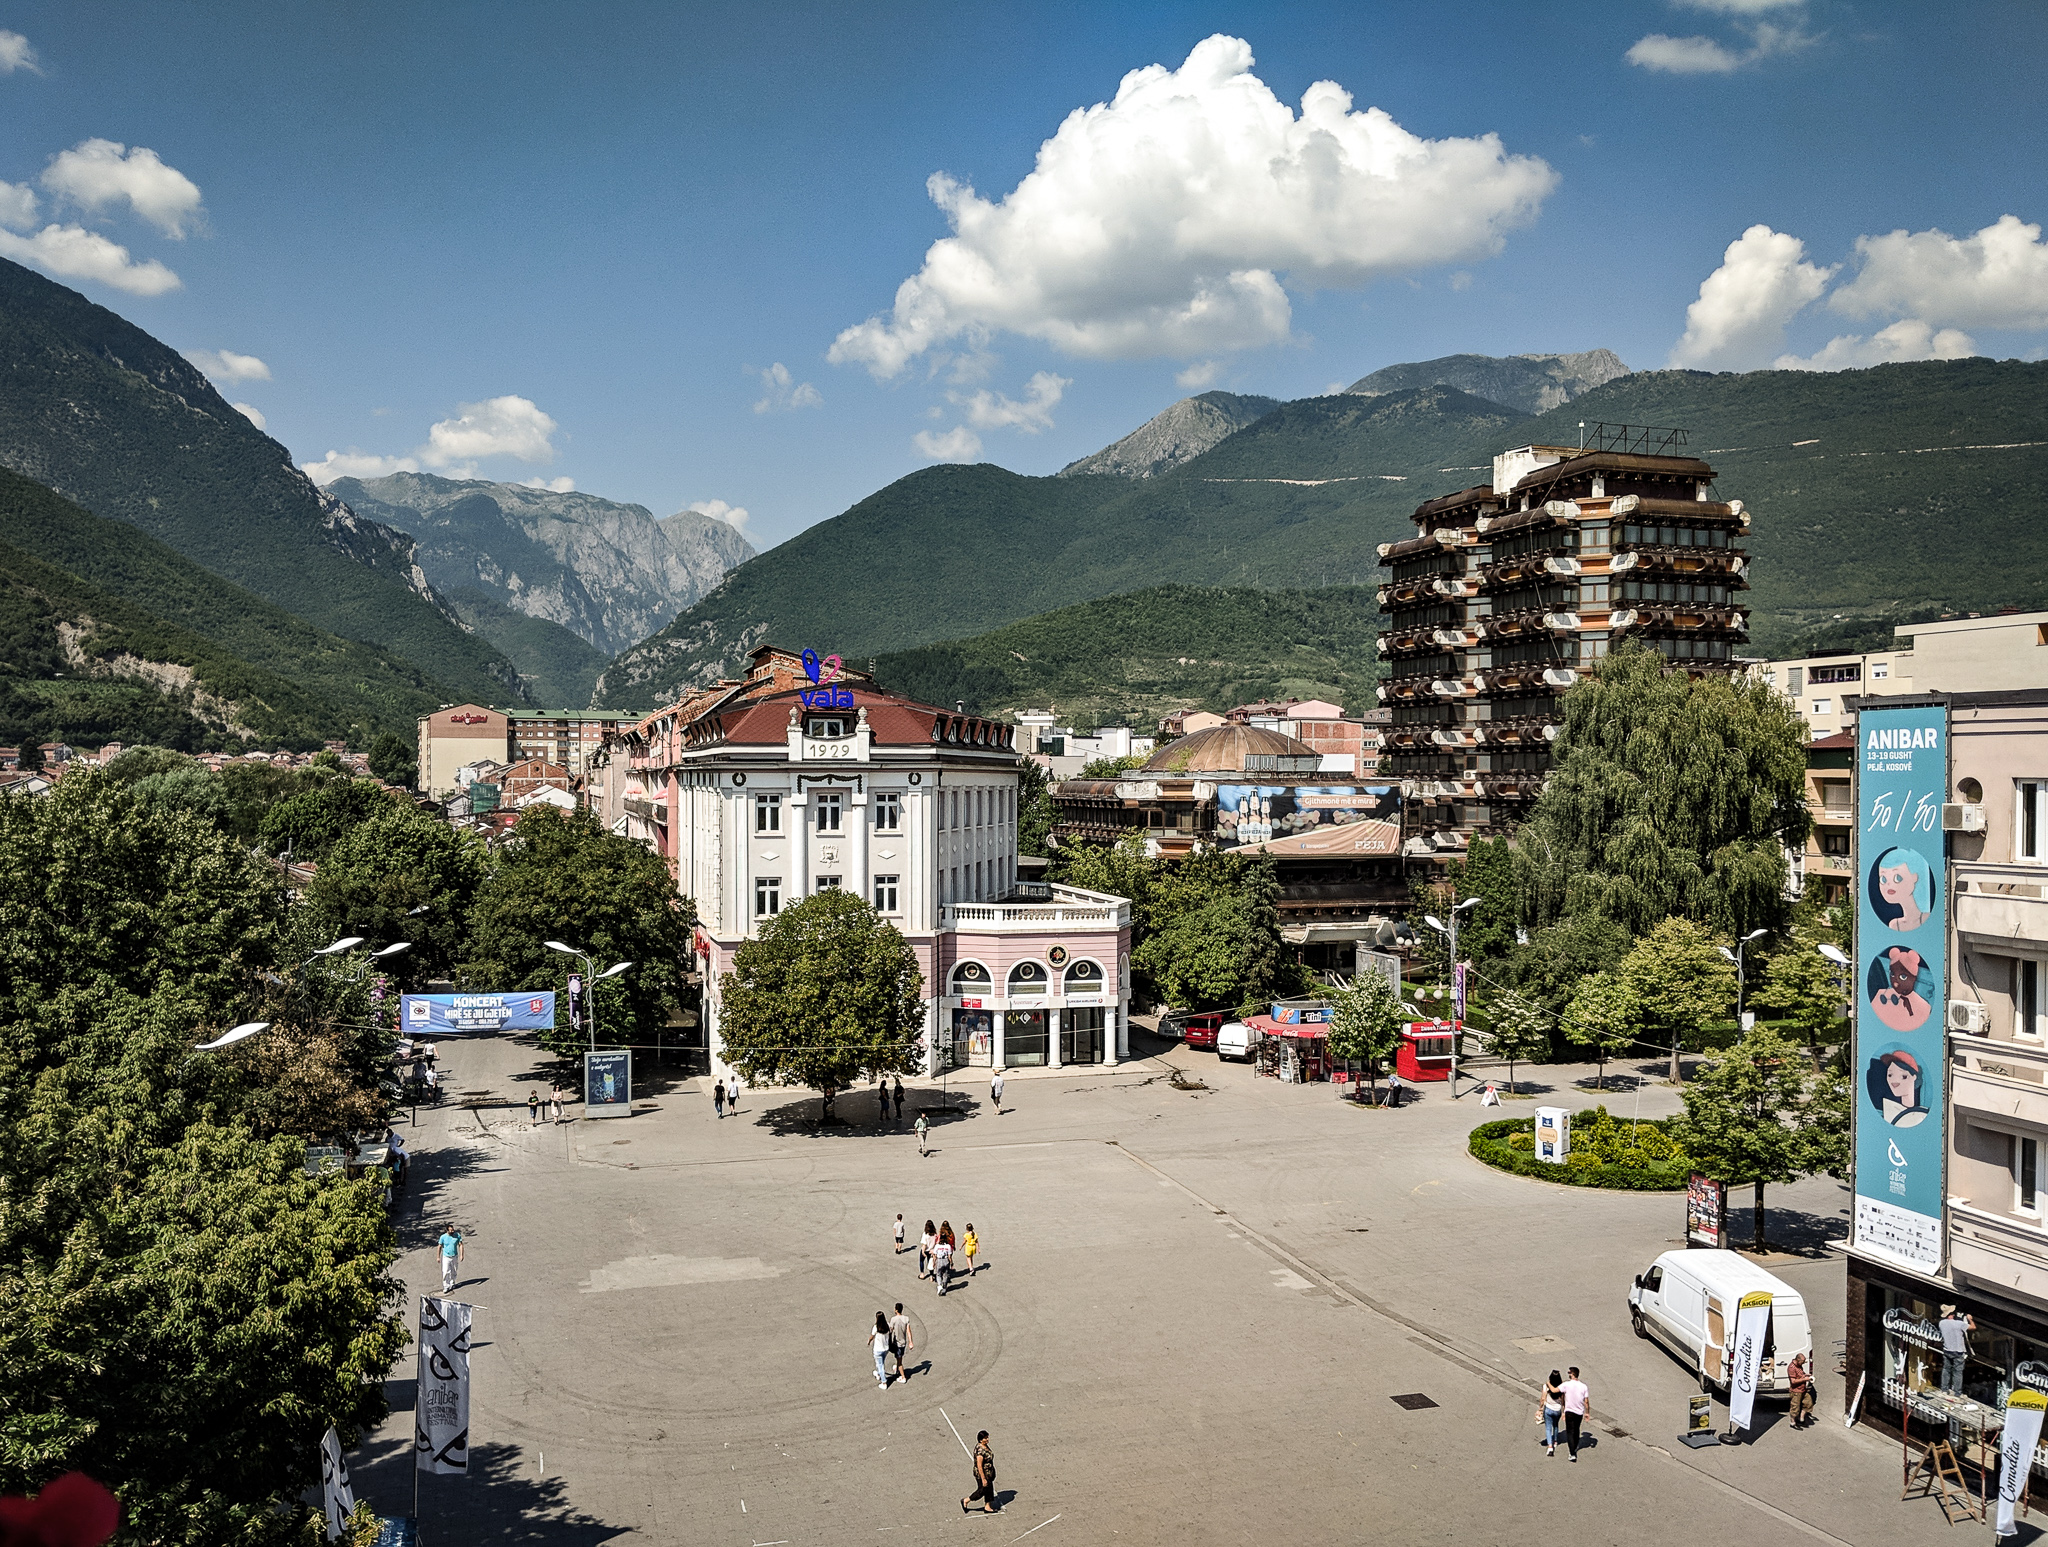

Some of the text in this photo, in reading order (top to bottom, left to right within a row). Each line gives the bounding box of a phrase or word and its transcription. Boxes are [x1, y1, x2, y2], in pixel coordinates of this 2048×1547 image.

[799, 683, 854, 708] vala
[1867, 727, 1938, 750] ANIBAR
[809, 744, 850, 758] 1929
[1867, 751, 1913, 760] 13-19 GUSHT
[1886, 762, 1913, 772] KOSOVË
[1355, 840, 1385, 850] PEJA
[453, 996, 504, 1008] KONCERT
[463, 1009, 473, 1018] SE
[473, 1009, 484, 1018] JU
[1305, 1012, 1322, 1022] Tini
[1742, 1299, 1769, 1307] AKSION
[1902, 1334, 1928, 1350] HOME
[1738, 1335, 1752, 1393] Comodita
[427, 1383, 459, 1407] anibar
[2010, 1400, 2044, 1410] AKSION
[1999, 1439, 2020, 1504] Comodita
